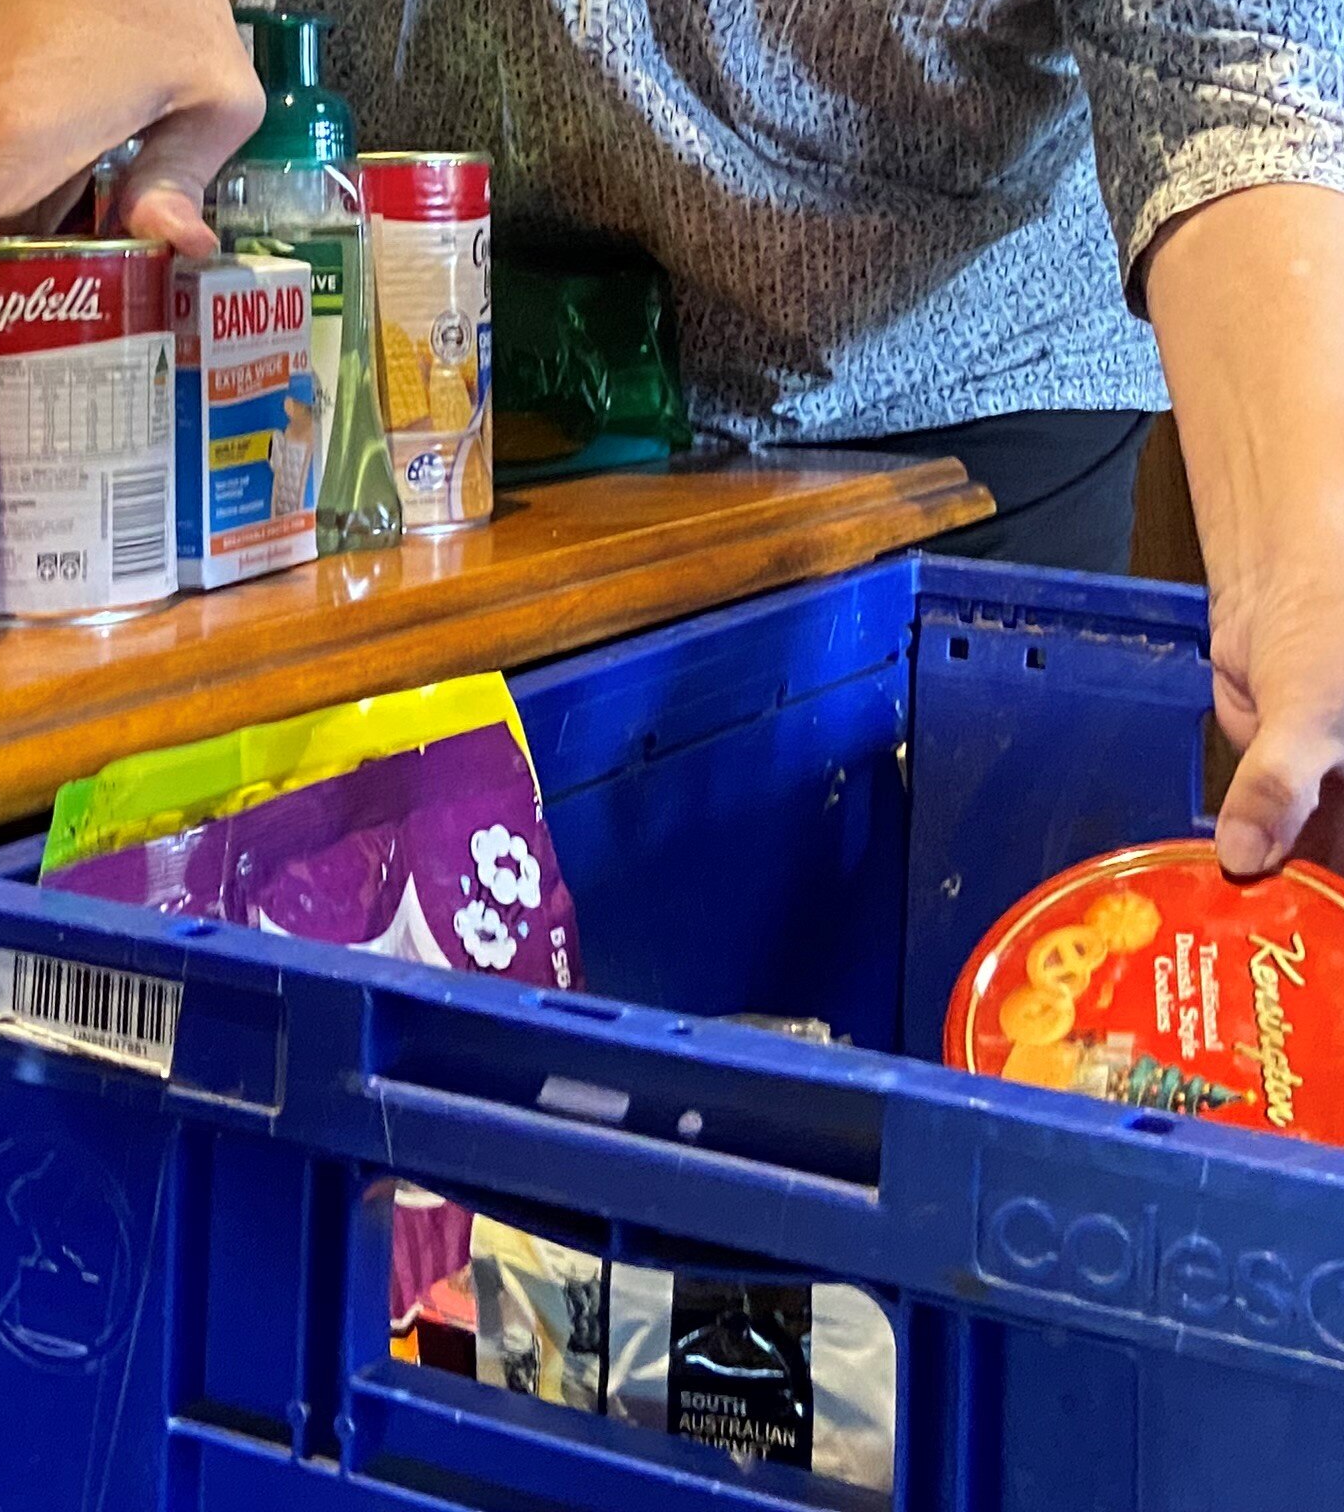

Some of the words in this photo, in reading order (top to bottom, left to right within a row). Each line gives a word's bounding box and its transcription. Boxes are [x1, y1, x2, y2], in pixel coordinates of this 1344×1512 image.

[292, 350, 308, 369] 40
[1154, 955, 1175, 1033] Cookies
[1175, 933, 1196, 1001] Danish
[1199, 941, 1224, 1052] Traditional
[1233, 931, 1306, 1128] Kensington
[989, 1194, 1296, 1327] coles
[679, 1411, 796, 1448] AUSTRALIAN
[680, 1390, 747, 1418] SOUTH
